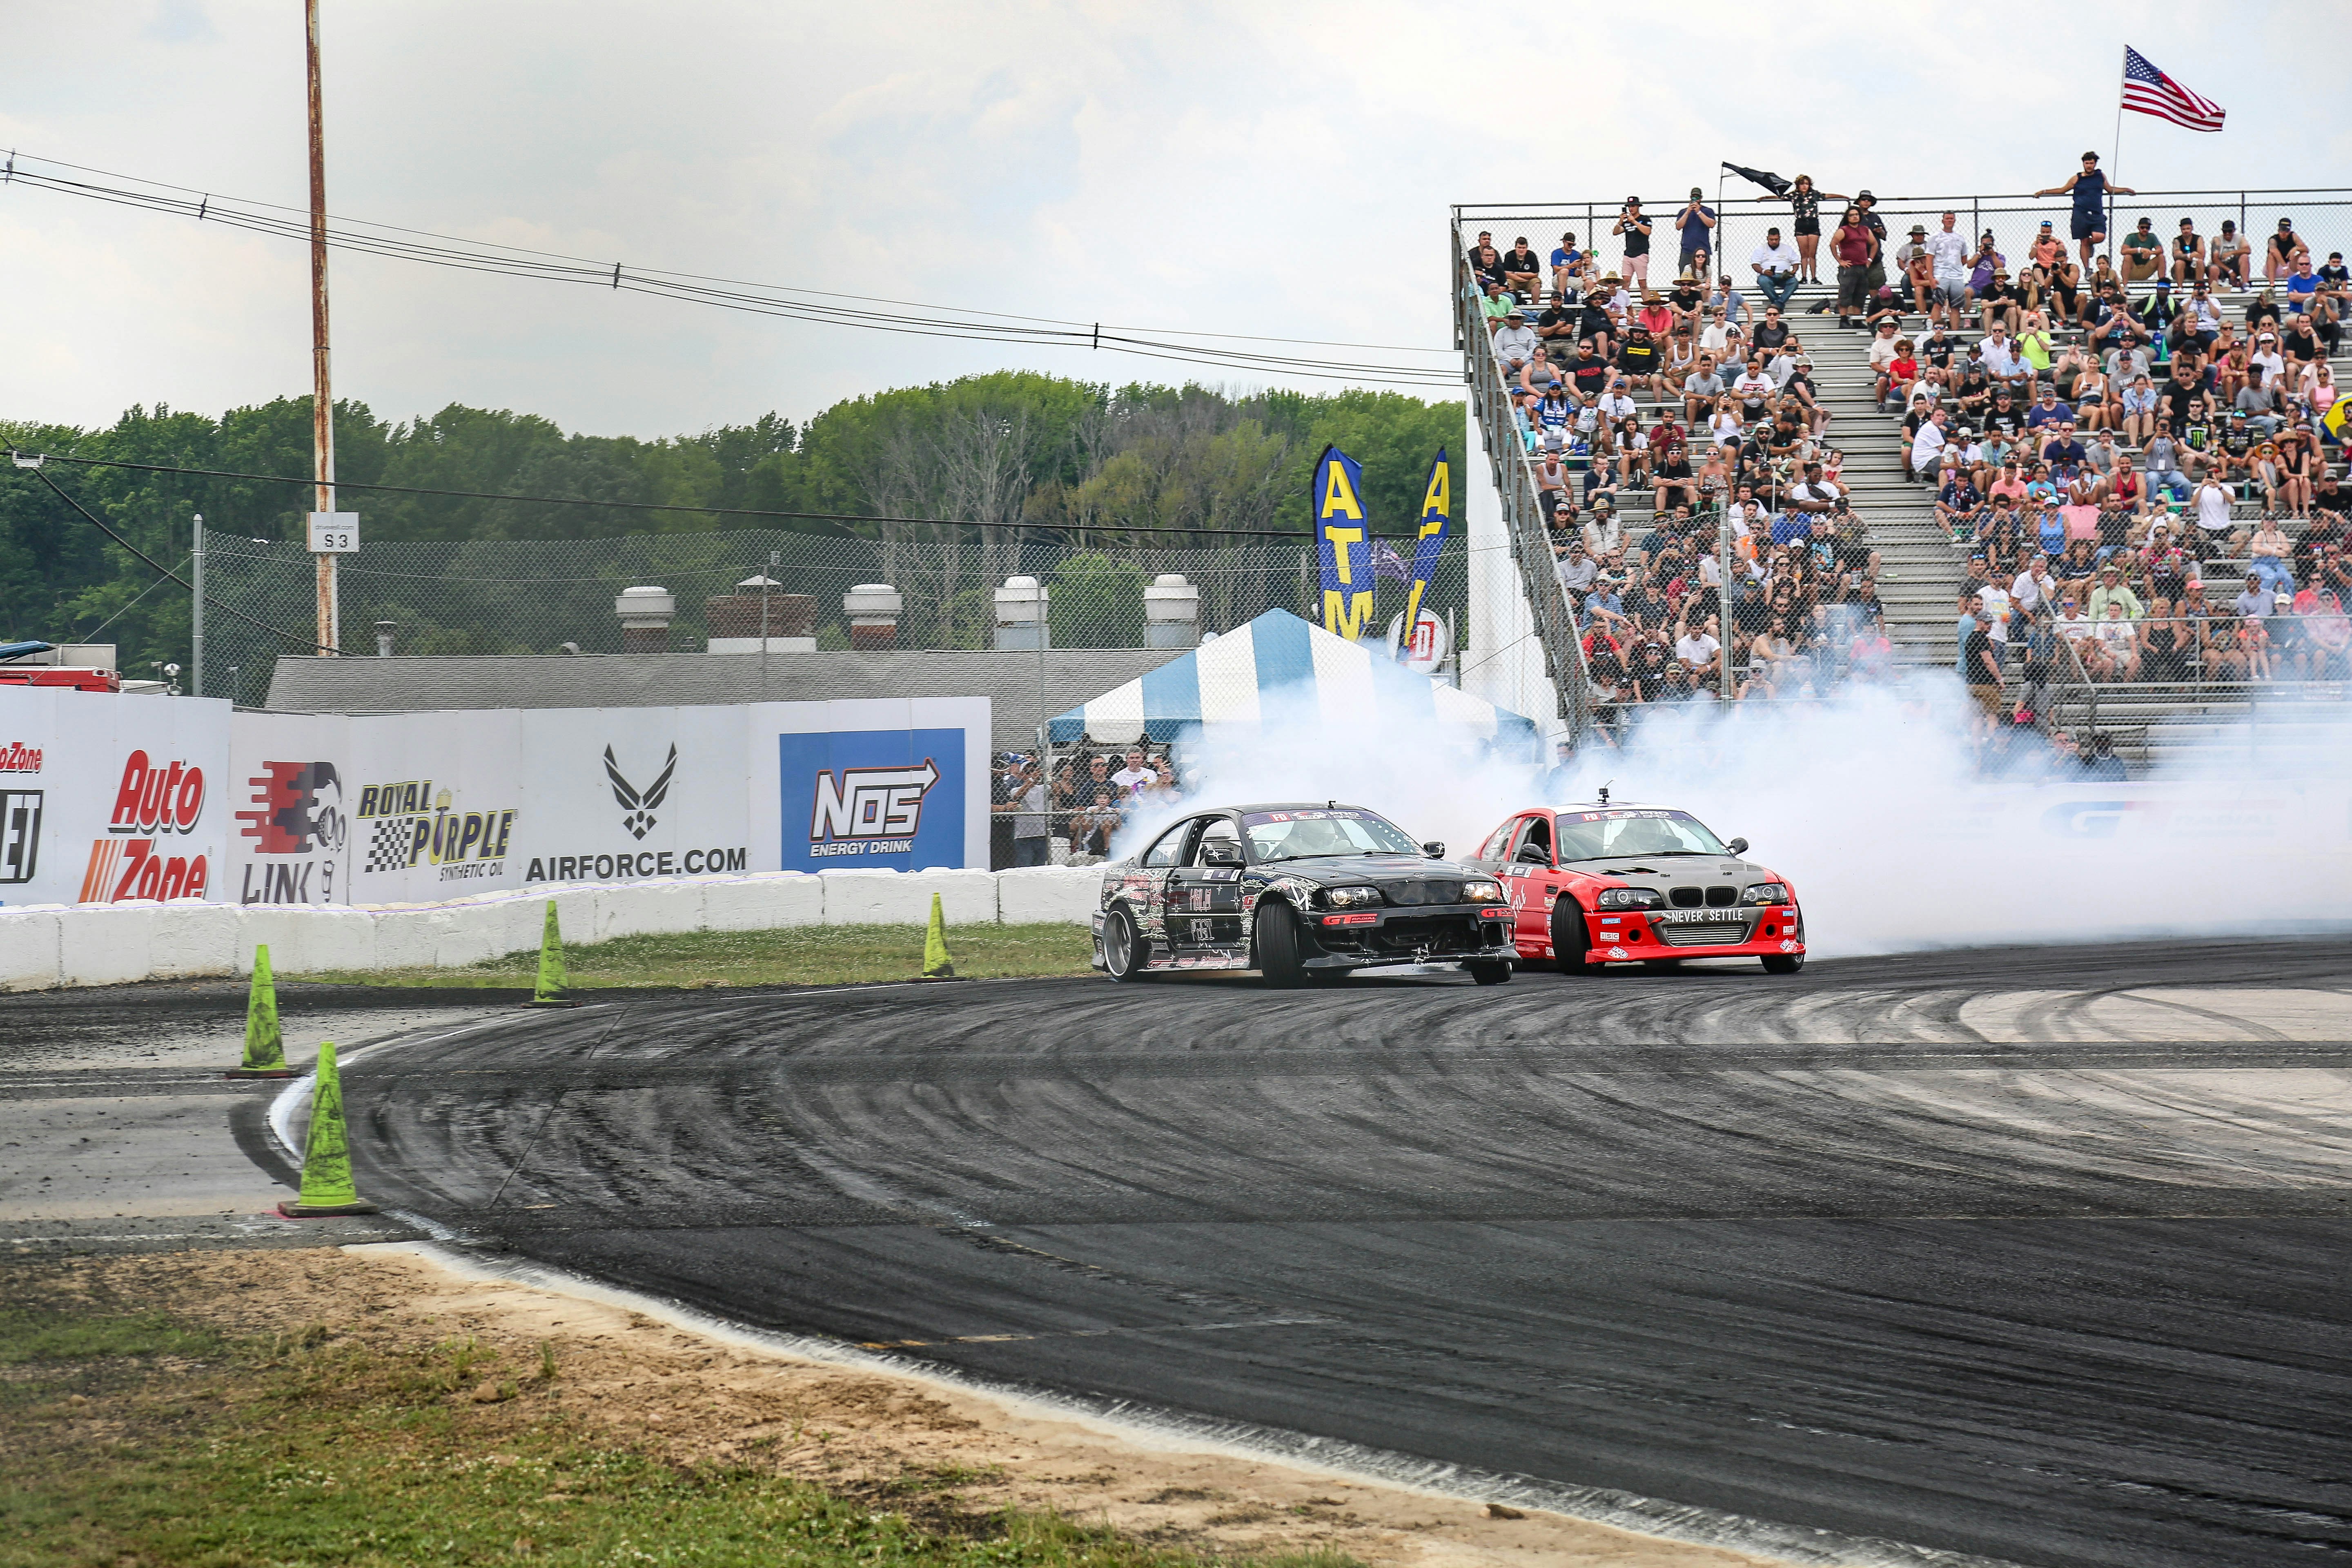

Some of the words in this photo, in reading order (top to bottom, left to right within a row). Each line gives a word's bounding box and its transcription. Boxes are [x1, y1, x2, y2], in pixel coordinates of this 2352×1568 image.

[325, 534, 333, 548] S
[339, 534, 347, 548] 3
[1321, 460, 1373, 642] ATM
[108, 749, 206, 835] Auto
[356, 780, 432, 819] ROYAL
[810, 758, 940, 842] NOS
[1272, 813, 1288, 821] FD
[1584, 813, 1599, 821] FD
[407, 808, 515, 868] PURPLE
[810, 841, 867, 857] ENERGY
[869, 838, 913, 854] DRINK
[112, 839, 208, 904] Zone
[439, 863, 486, 882] SYNTHETIC
[525, 847, 747, 882] AIRFORCE.COM
[242, 862, 316, 905] LINK
[1322, 914, 1355, 925] GT
[1660, 911, 1672, 920] TEAM
[1672, 910, 1704, 923] NEVER
[1708, 909, 1743, 921] SETTLE
